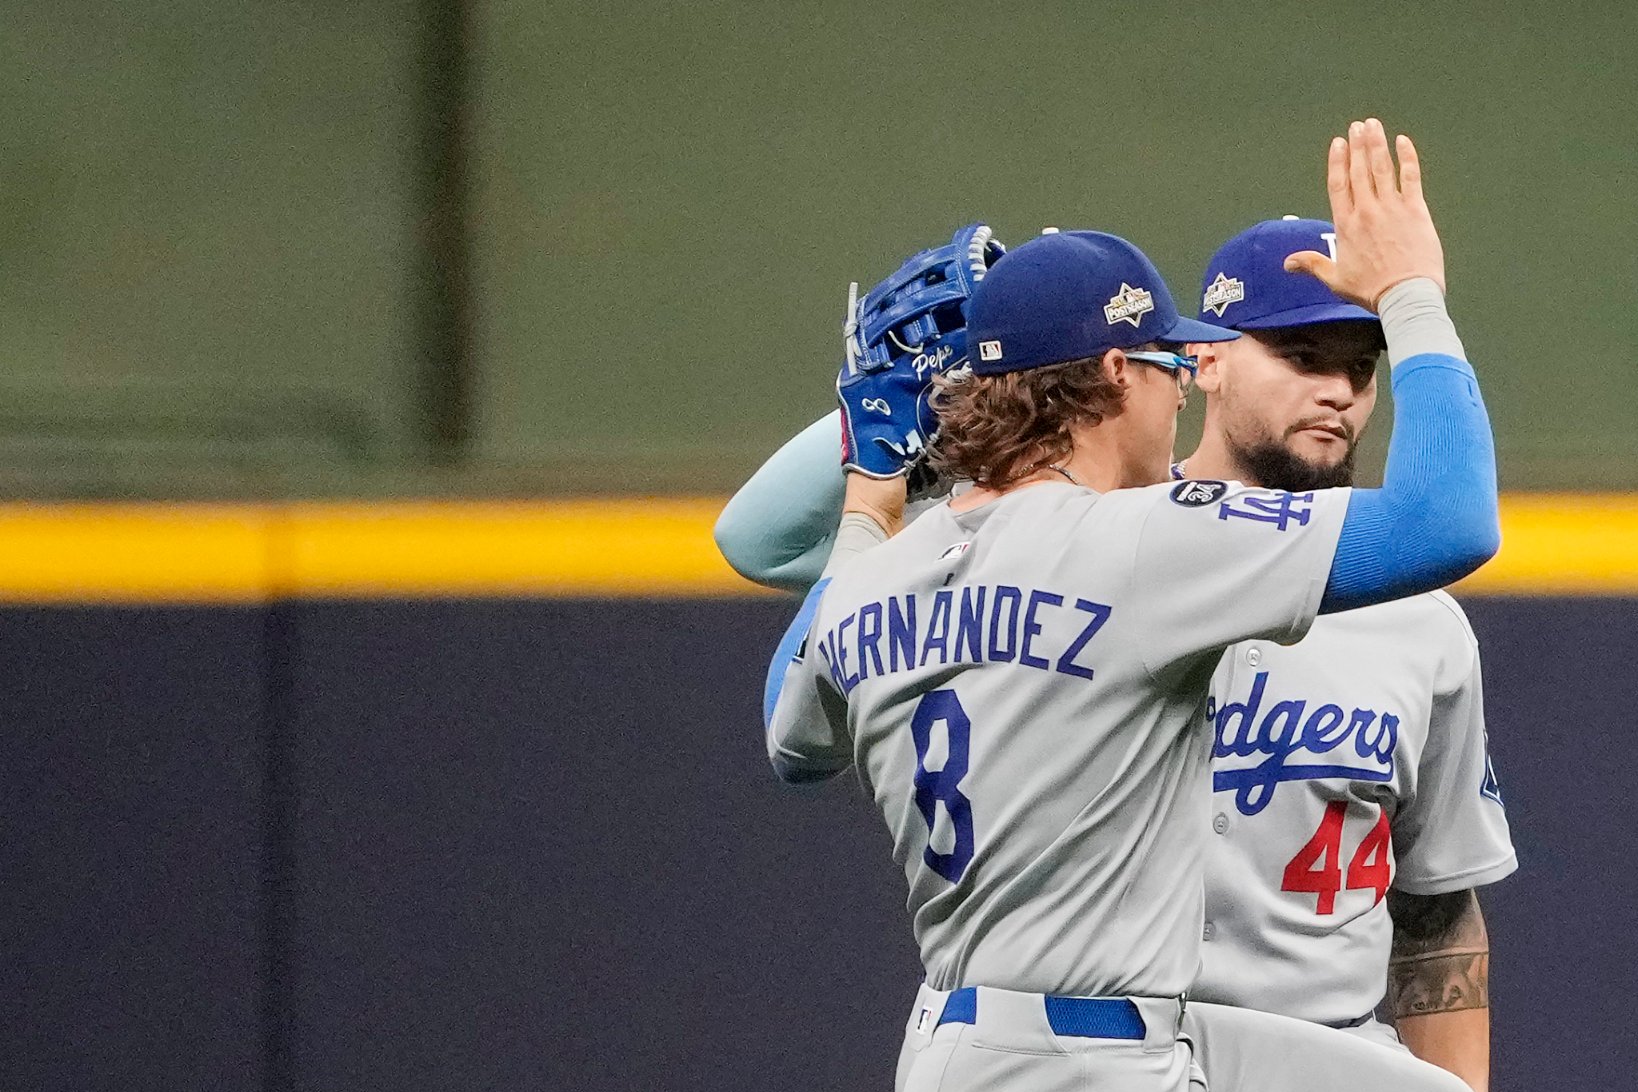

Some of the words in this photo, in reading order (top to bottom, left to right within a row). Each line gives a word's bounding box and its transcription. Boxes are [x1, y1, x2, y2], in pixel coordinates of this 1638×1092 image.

[912, 344, 953, 381] Pepe
[1218, 491, 1314, 532] LA
[910, 688, 975, 884] 8
[1206, 671, 1400, 816] dgers
[1280, 800, 1391, 916] 44
